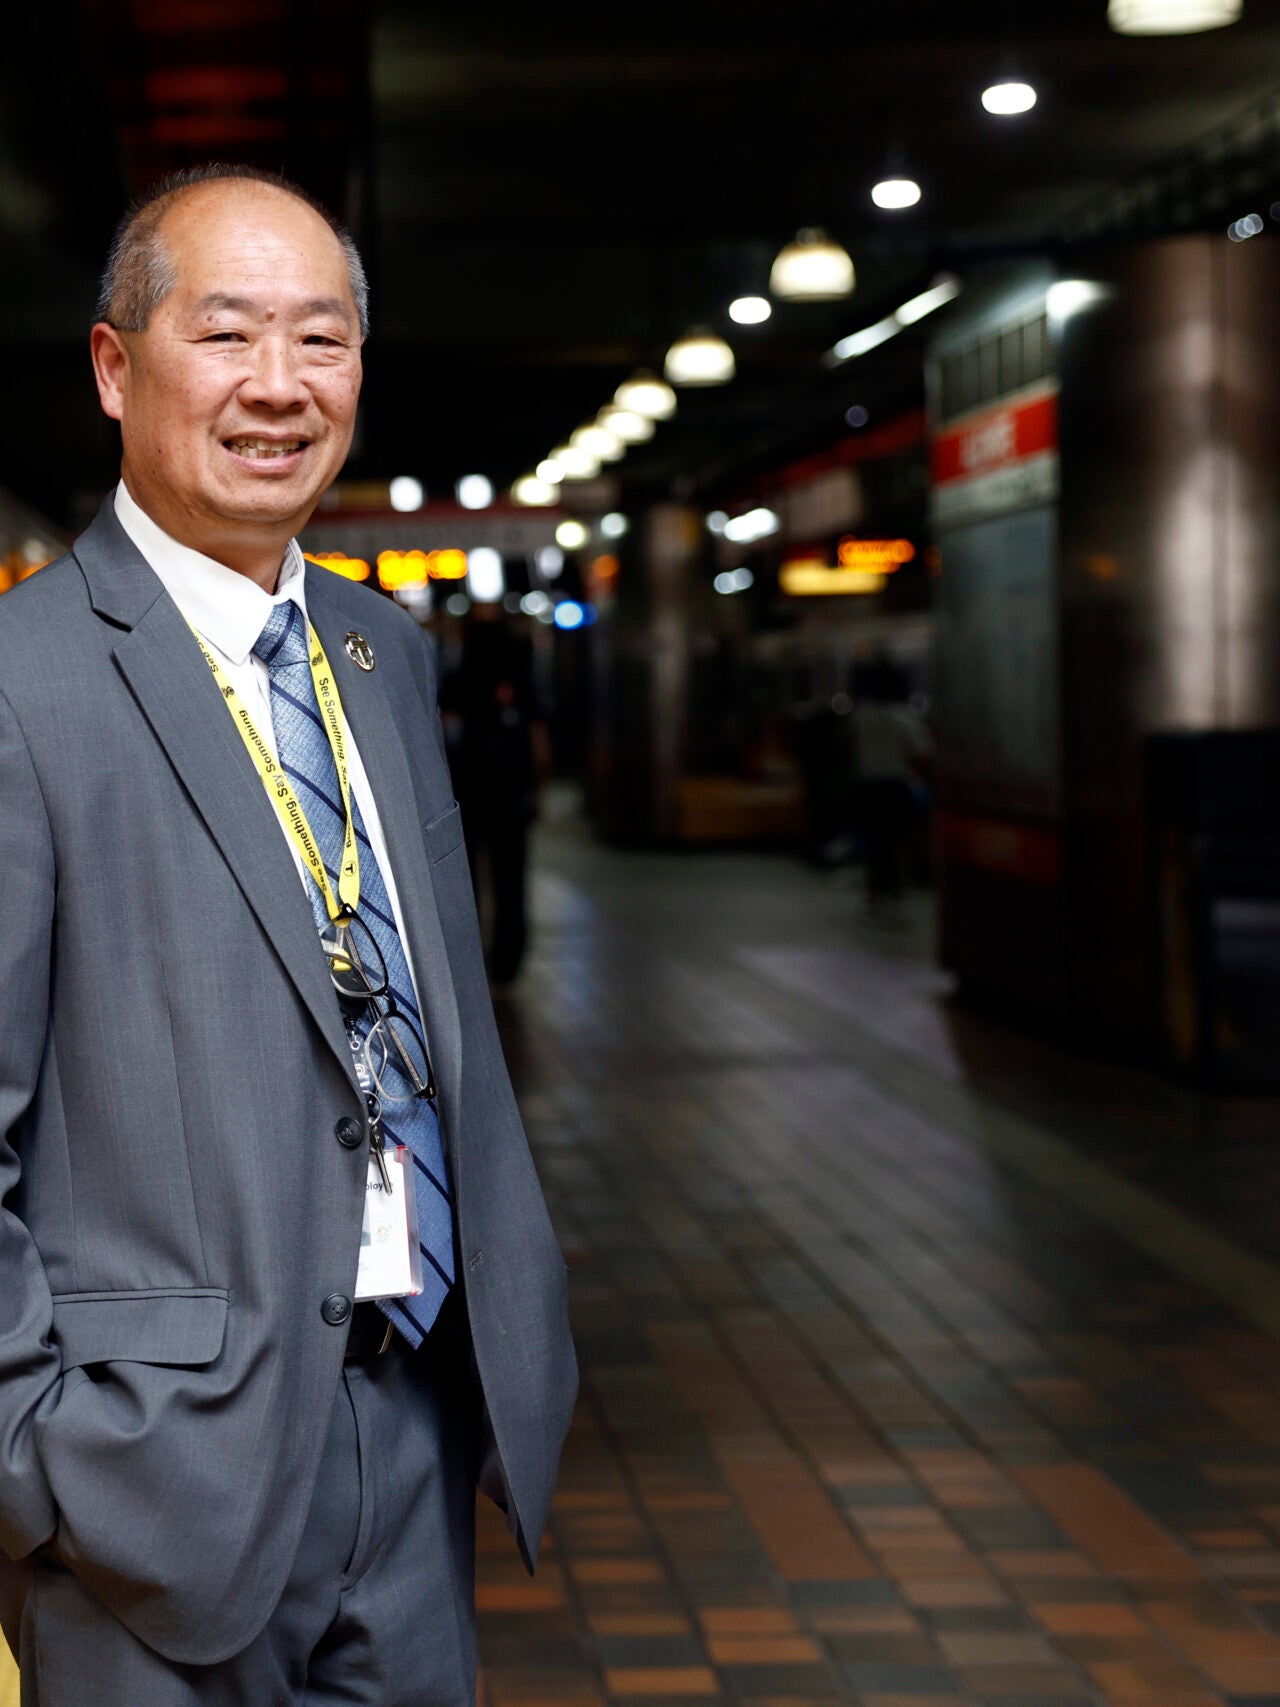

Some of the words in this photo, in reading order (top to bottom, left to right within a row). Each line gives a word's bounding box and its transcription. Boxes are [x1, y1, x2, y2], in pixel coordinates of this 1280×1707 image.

[319, 677, 330, 697] See
[239, 709, 276, 773] Something
[273, 774, 288, 797] Say
[286, 797, 320, 867] Something,
[318, 868, 327, 892] See
